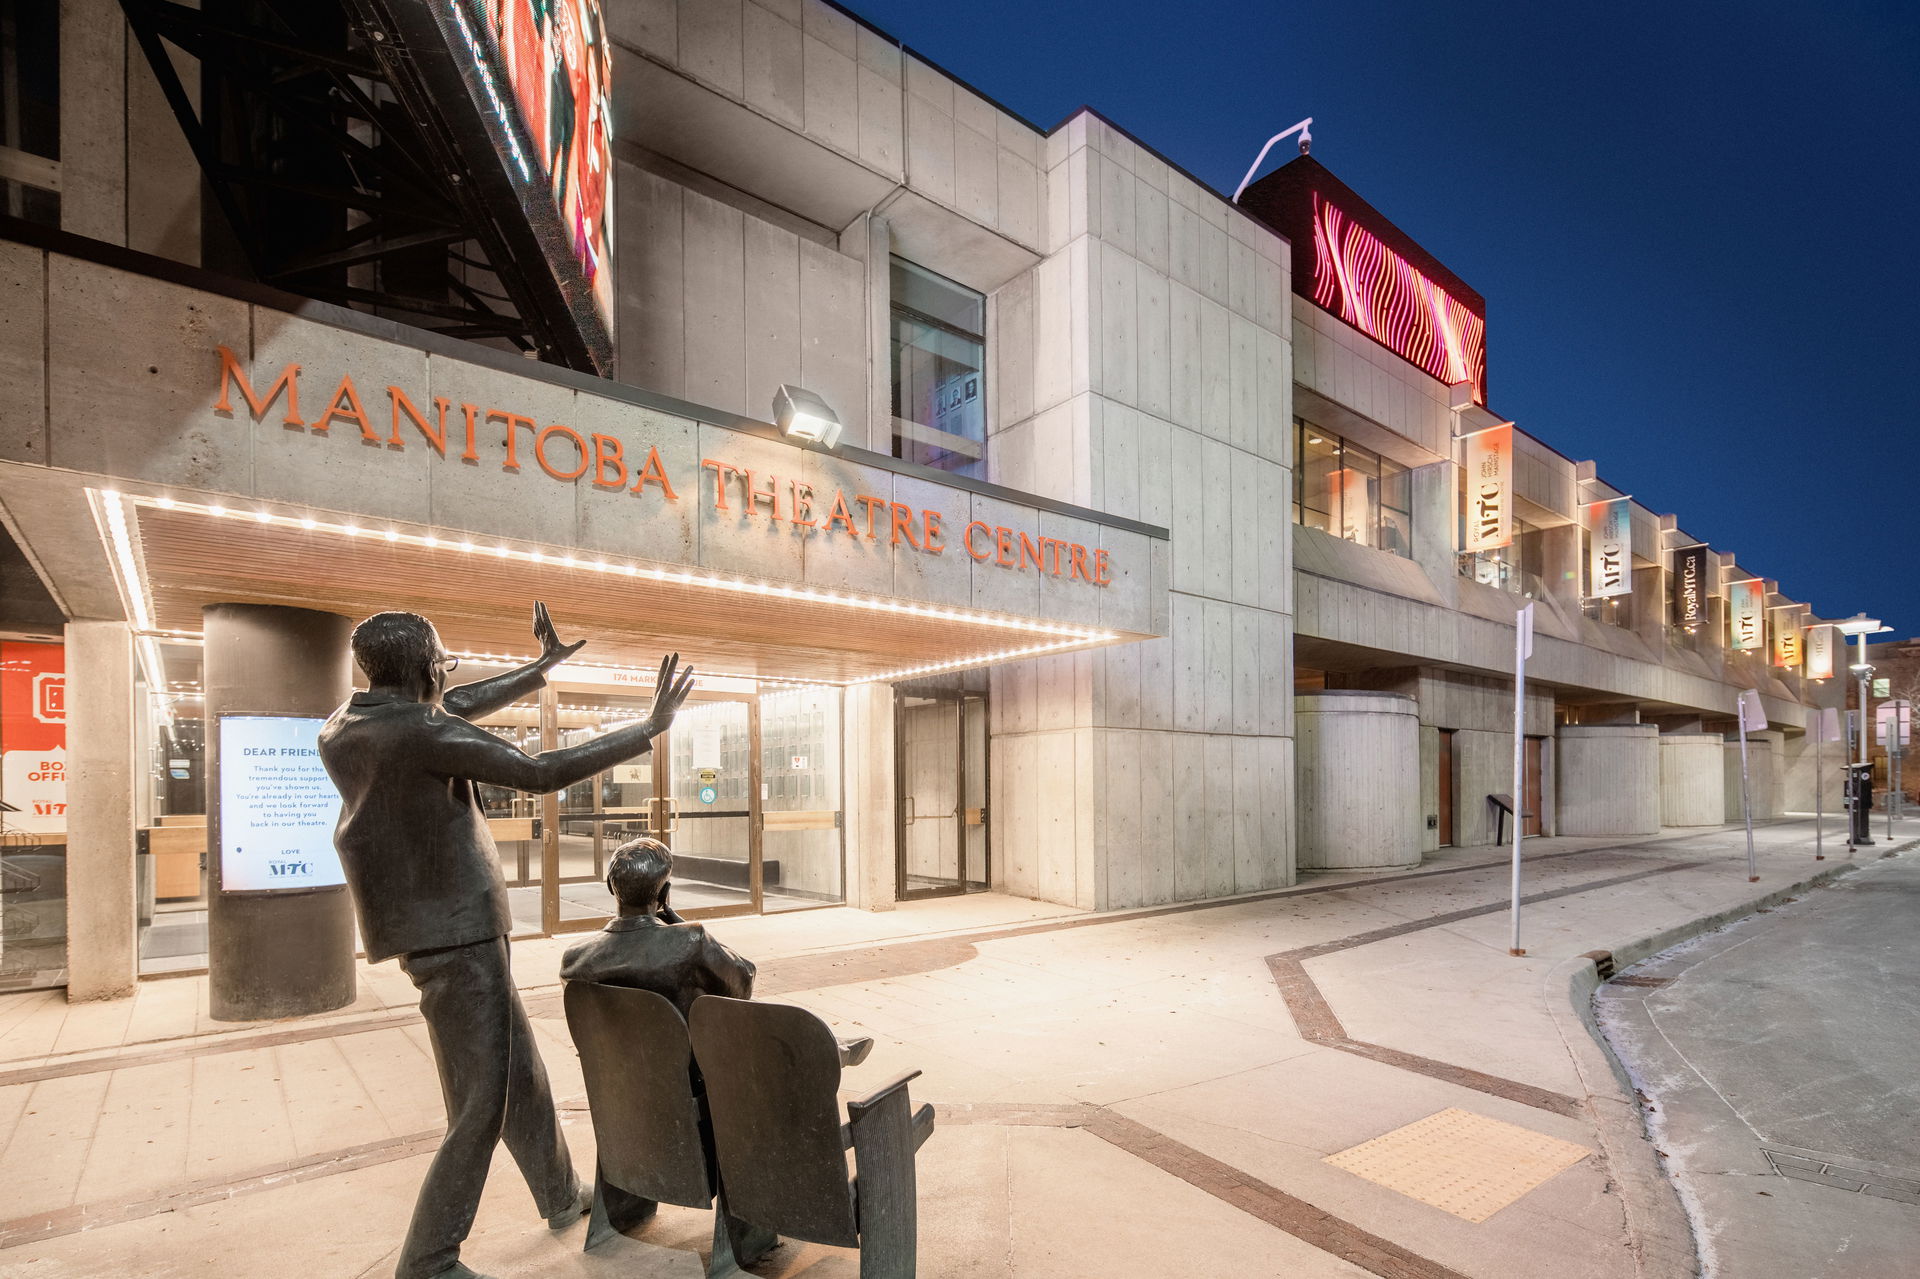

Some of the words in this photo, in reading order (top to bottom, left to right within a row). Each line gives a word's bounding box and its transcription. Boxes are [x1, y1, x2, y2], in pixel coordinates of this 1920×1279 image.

[214, 345, 679, 500] MANITOBA
[702, 458, 945, 552] THEATRE
[964, 520, 1112, 585] CENTRE
[1476, 482, 1499, 539] MTC
[1683, 555, 1699, 620] RoyalMTC.ca
[613, 673, 627, 681] 174
[630, 675, 656, 684] MARK
[243, 747, 277, 756] DEAR
[40, 761, 66, 771] BO
[28, 772, 66, 781] OFFI
[33, 803, 67, 815] MT
[269, 861, 314, 876] MTC
